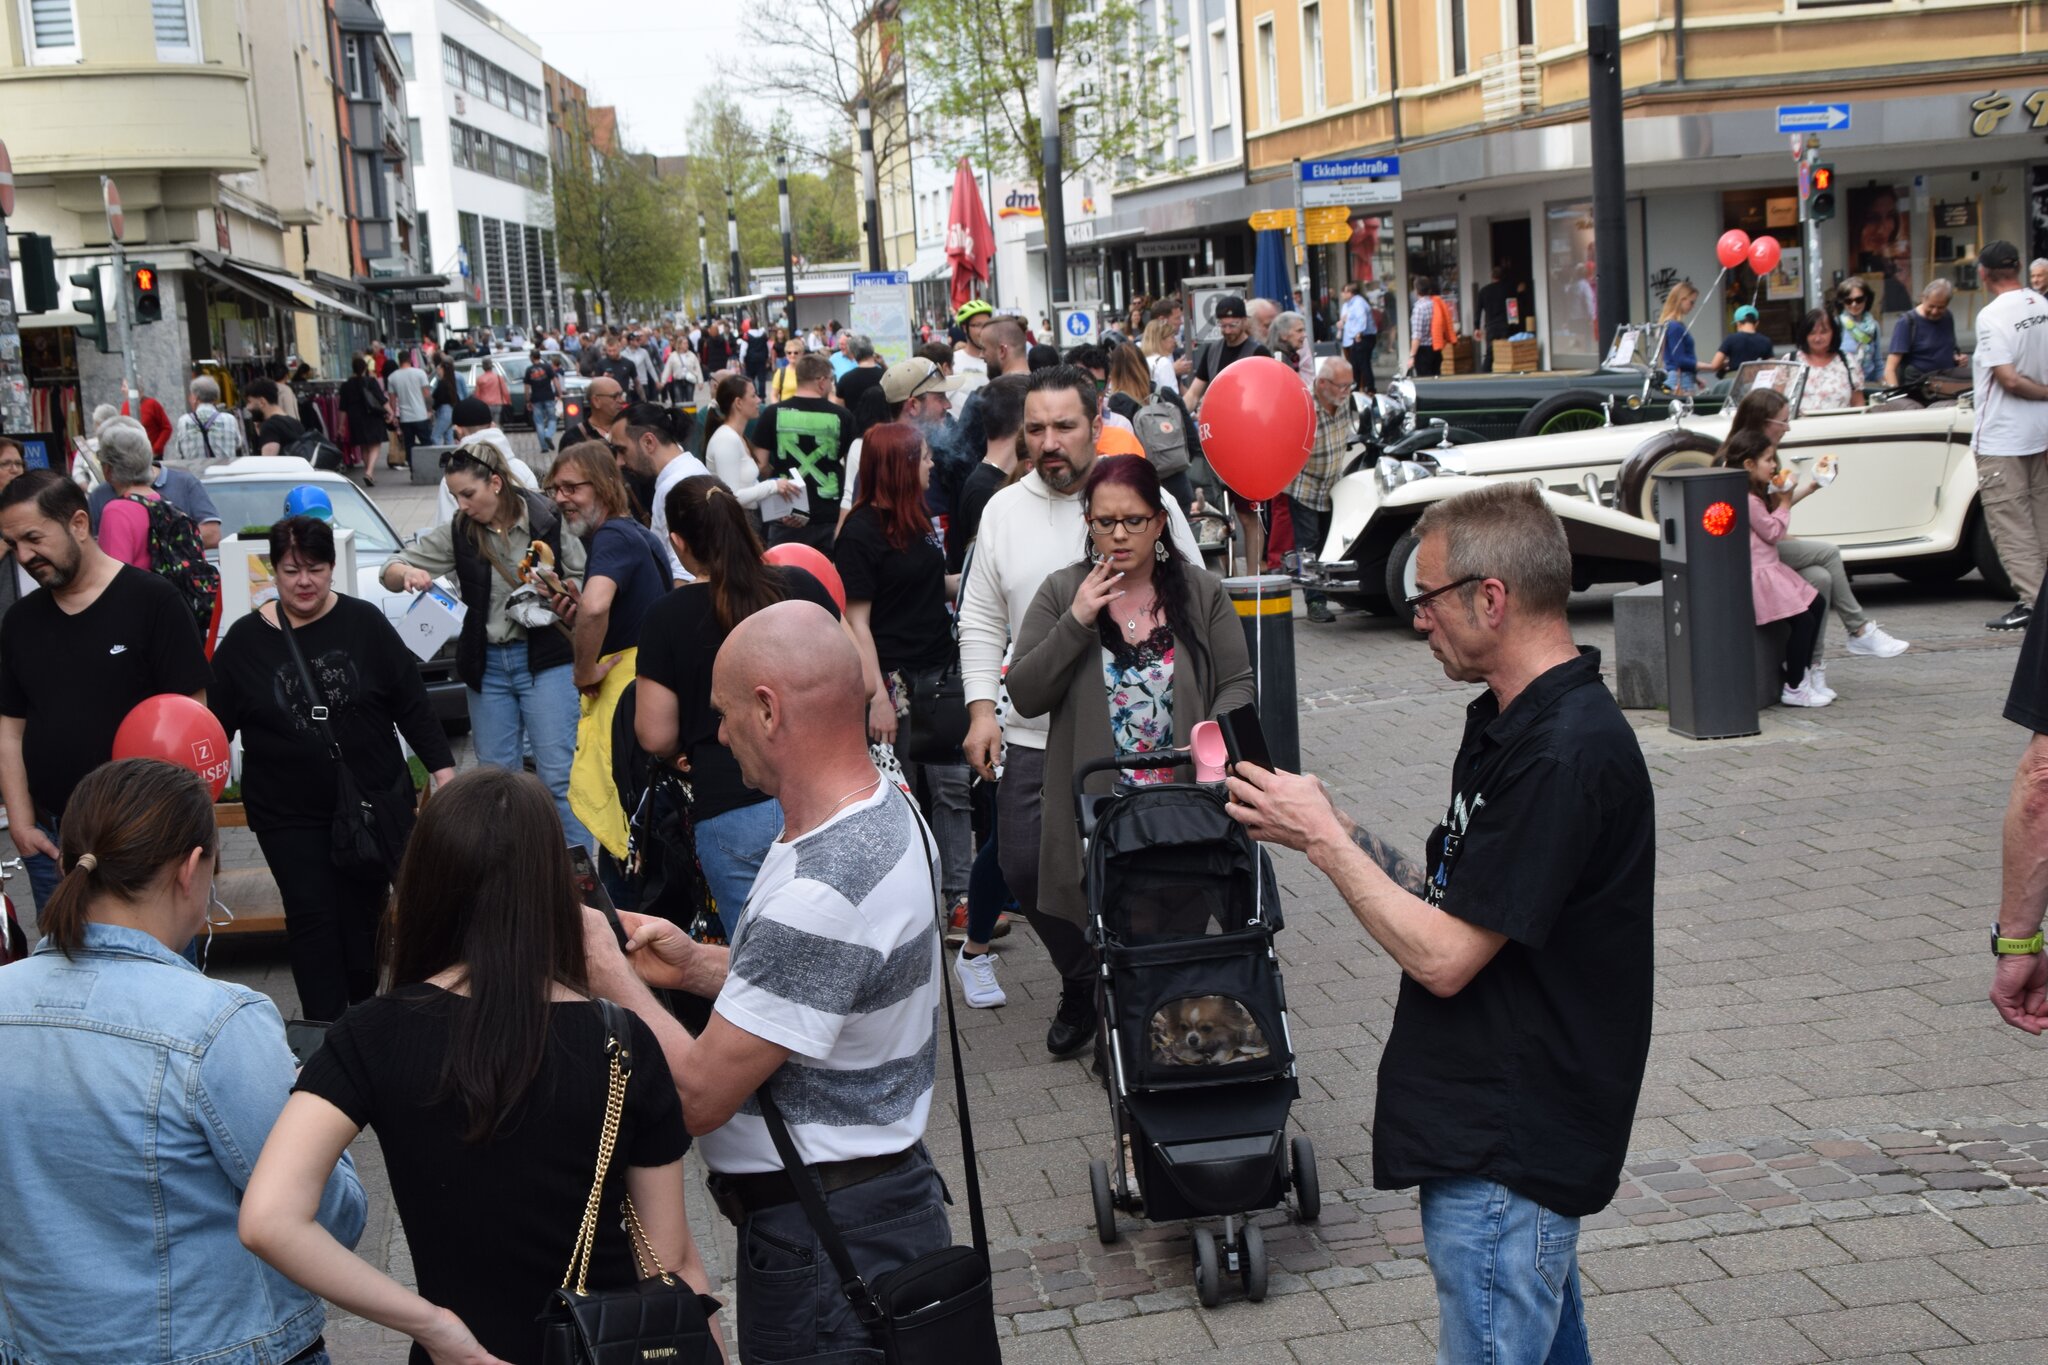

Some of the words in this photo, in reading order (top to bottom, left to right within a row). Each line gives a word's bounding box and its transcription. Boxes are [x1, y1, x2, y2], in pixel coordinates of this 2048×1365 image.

[1312, 160, 1389, 178] Ekkehardstraße
[1005, 190, 1035, 207] dm
[855, 276, 888, 287] SINGEN
[198, 745, 210, 760] Z
